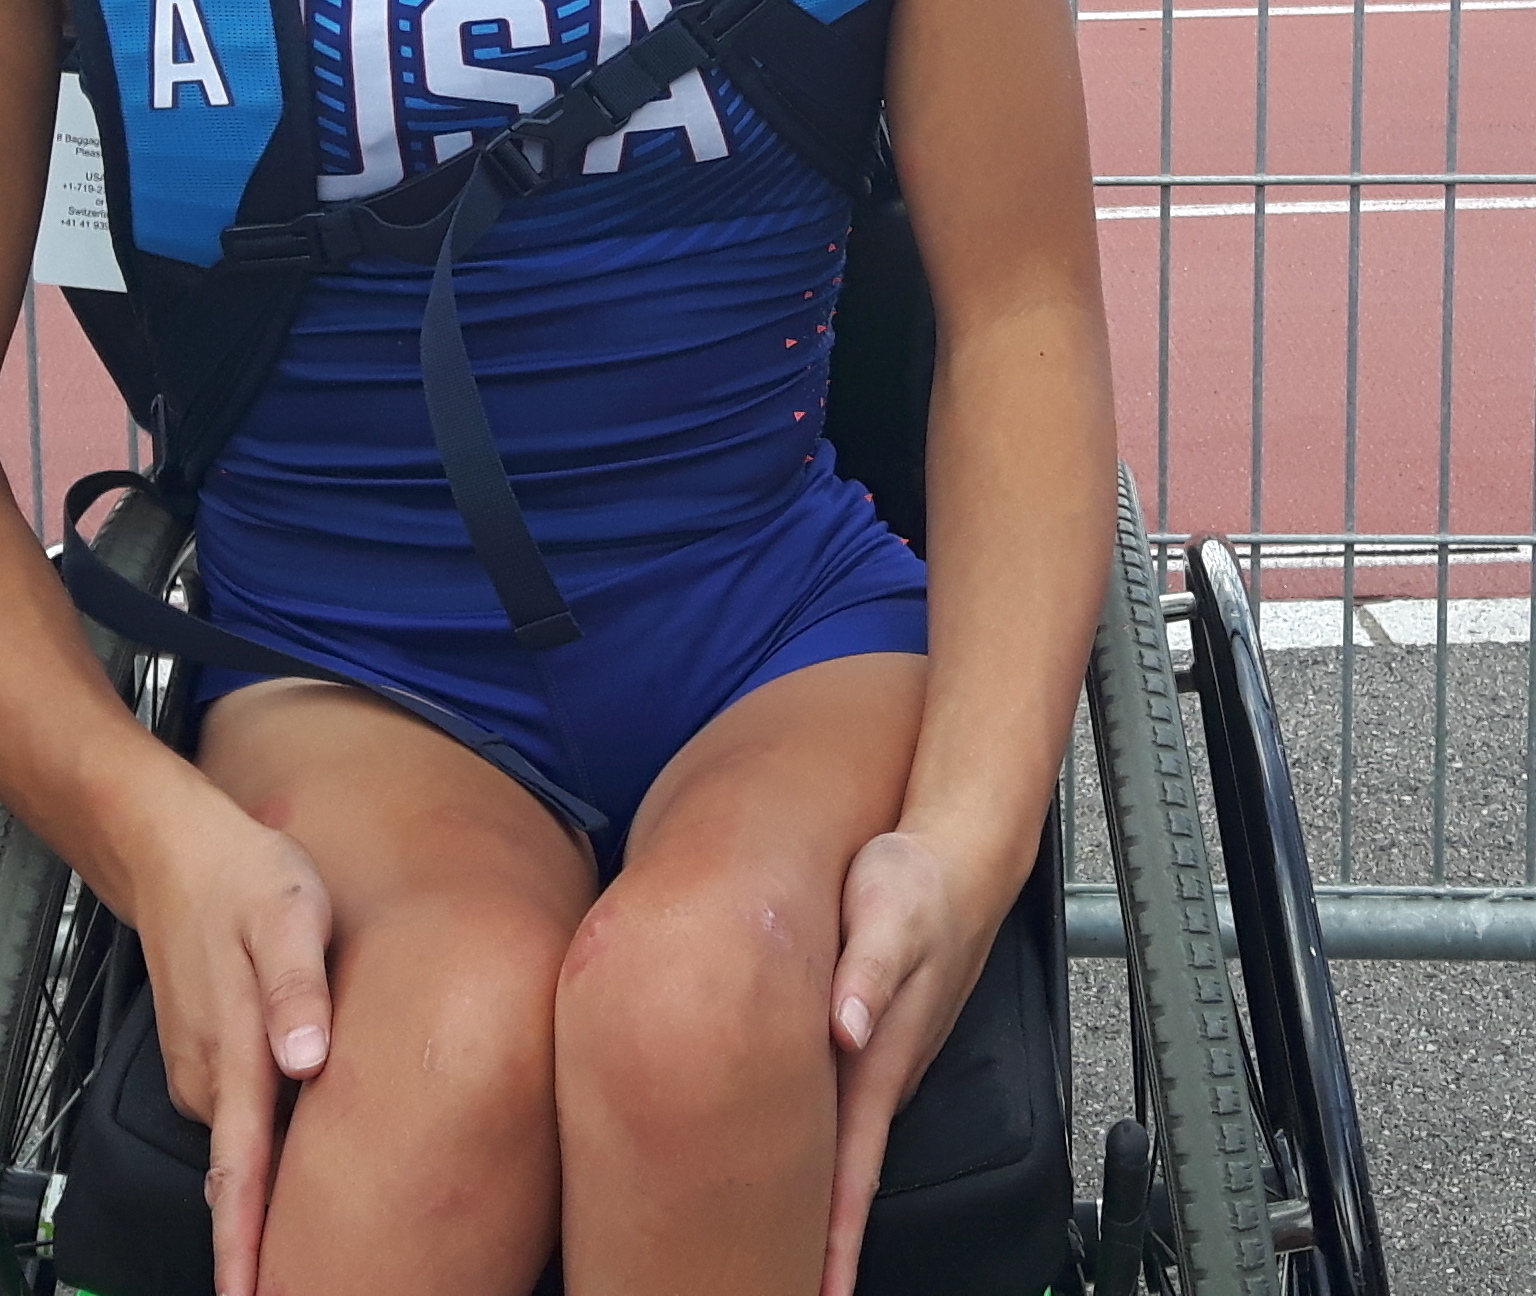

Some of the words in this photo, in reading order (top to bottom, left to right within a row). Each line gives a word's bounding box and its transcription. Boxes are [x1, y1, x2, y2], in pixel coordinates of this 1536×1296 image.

[65, 134, 100, 148] Baggag
[75, 147, 101, 158] Pleas
[63, 182, 103, 195] +1-719-2
[68, 206, 107, 219] Switzerl
